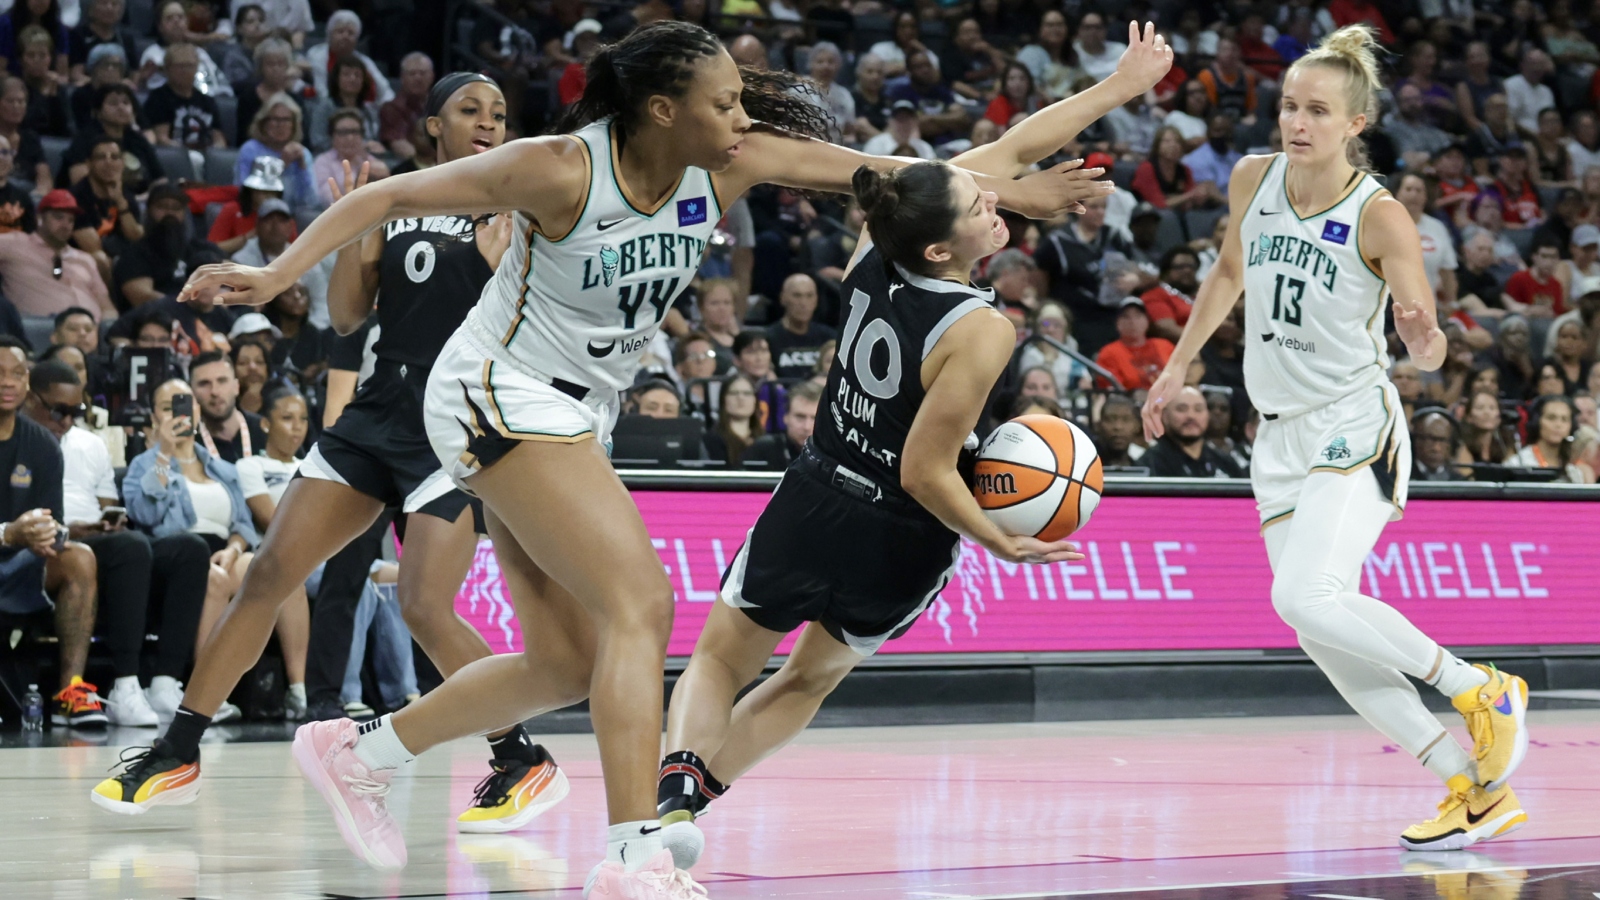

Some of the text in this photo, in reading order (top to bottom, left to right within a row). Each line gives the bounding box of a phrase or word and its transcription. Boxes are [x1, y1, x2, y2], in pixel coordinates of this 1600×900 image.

[383, 215, 474, 243] LAS VEGAS
[404, 240, 436, 284] 0
[1271, 273, 1307, 327] 13
[838, 287, 902, 399] 10
[130, 355, 148, 401] F
[837, 376, 877, 428] PLUM
[983, 541, 1194, 600] MIELLE
[1364, 542, 1549, 599] MIELLE
